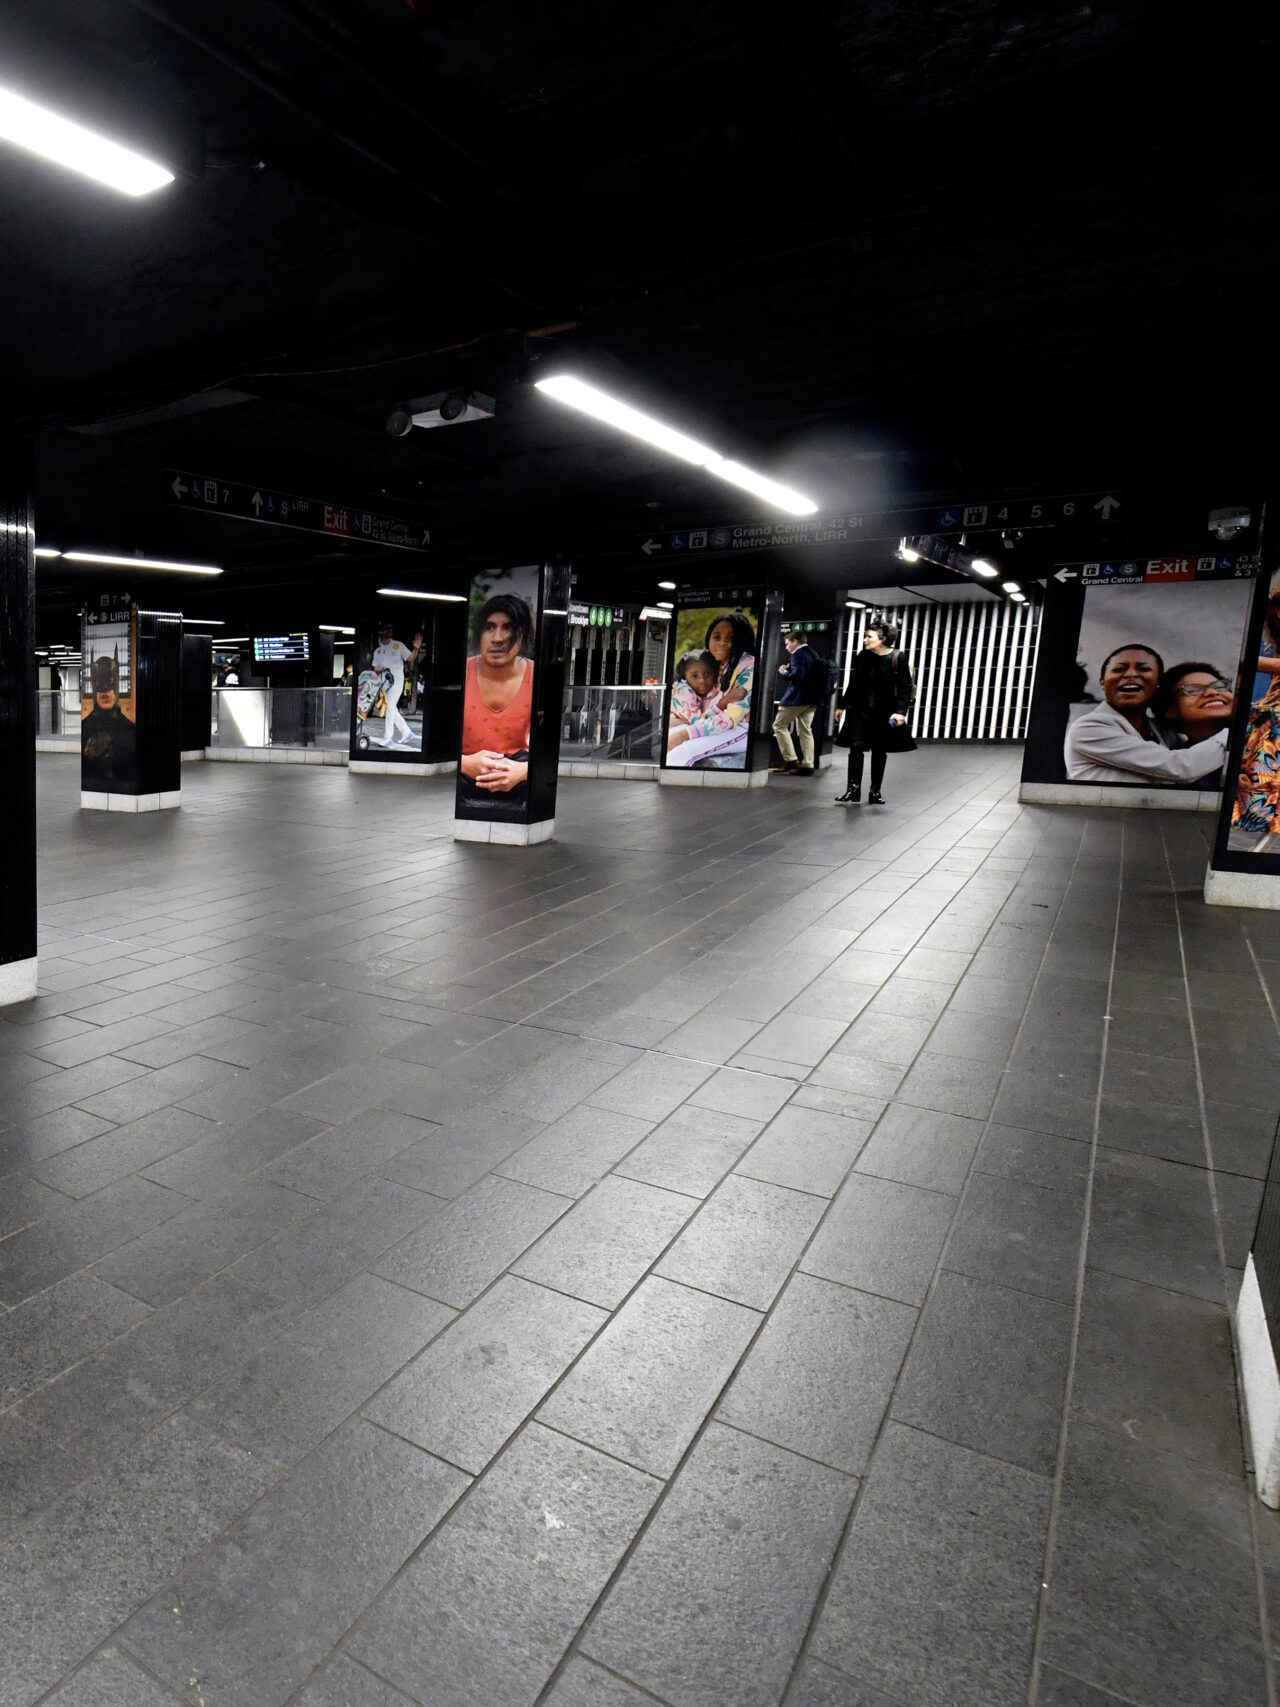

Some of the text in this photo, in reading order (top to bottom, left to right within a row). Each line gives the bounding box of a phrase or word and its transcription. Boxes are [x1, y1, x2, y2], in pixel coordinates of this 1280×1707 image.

[222, 489, 230, 504] 7
[291, 499, 310, 513] LIRR
[997, 502, 1076, 520] 4 5 6
[323, 505, 348, 531] Exit
[733, 525, 771, 538] Grand
[828, 519, 845, 530] 42
[848, 517, 864, 528] St
[714, 533, 726, 544] S
[815, 530, 848, 542] LIRR
[1123, 564, 1134, 574] S
[1146, 559, 1189, 575] Exit
[1081, 575, 1144, 586] Grand Central
[109, 611, 130, 622] LIRR
